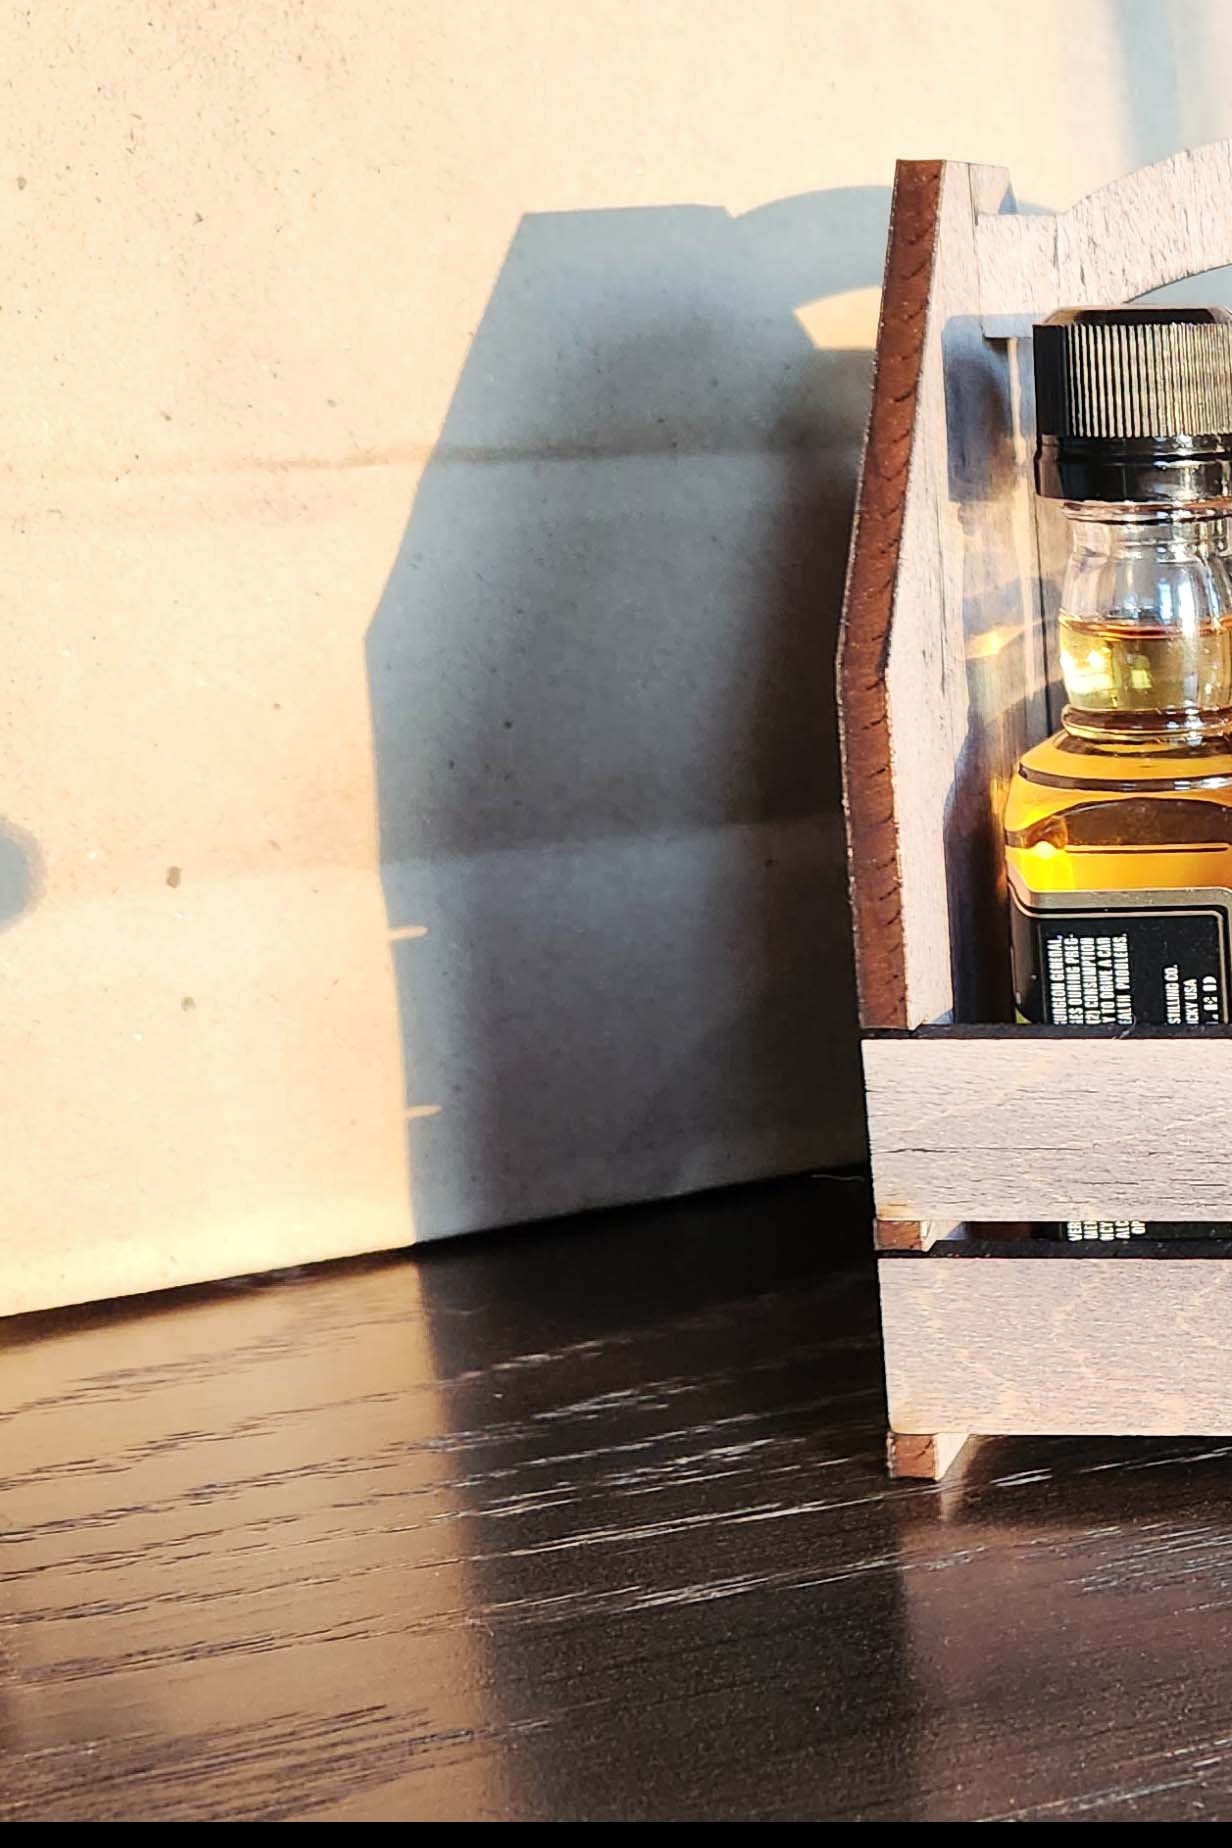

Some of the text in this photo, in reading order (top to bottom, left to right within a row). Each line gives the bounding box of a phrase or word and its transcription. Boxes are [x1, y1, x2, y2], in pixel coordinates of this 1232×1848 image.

[1096, 938, 1111, 957] CAR
[1080, 938, 1099, 1008] CONSUMPTION
[1164, 964, 1178, 981] CO.
[1098, 970, 1115, 998] DRIVE
[1183, 979, 1197, 999] USA
[1100, 1002, 1115, 1014] TO
